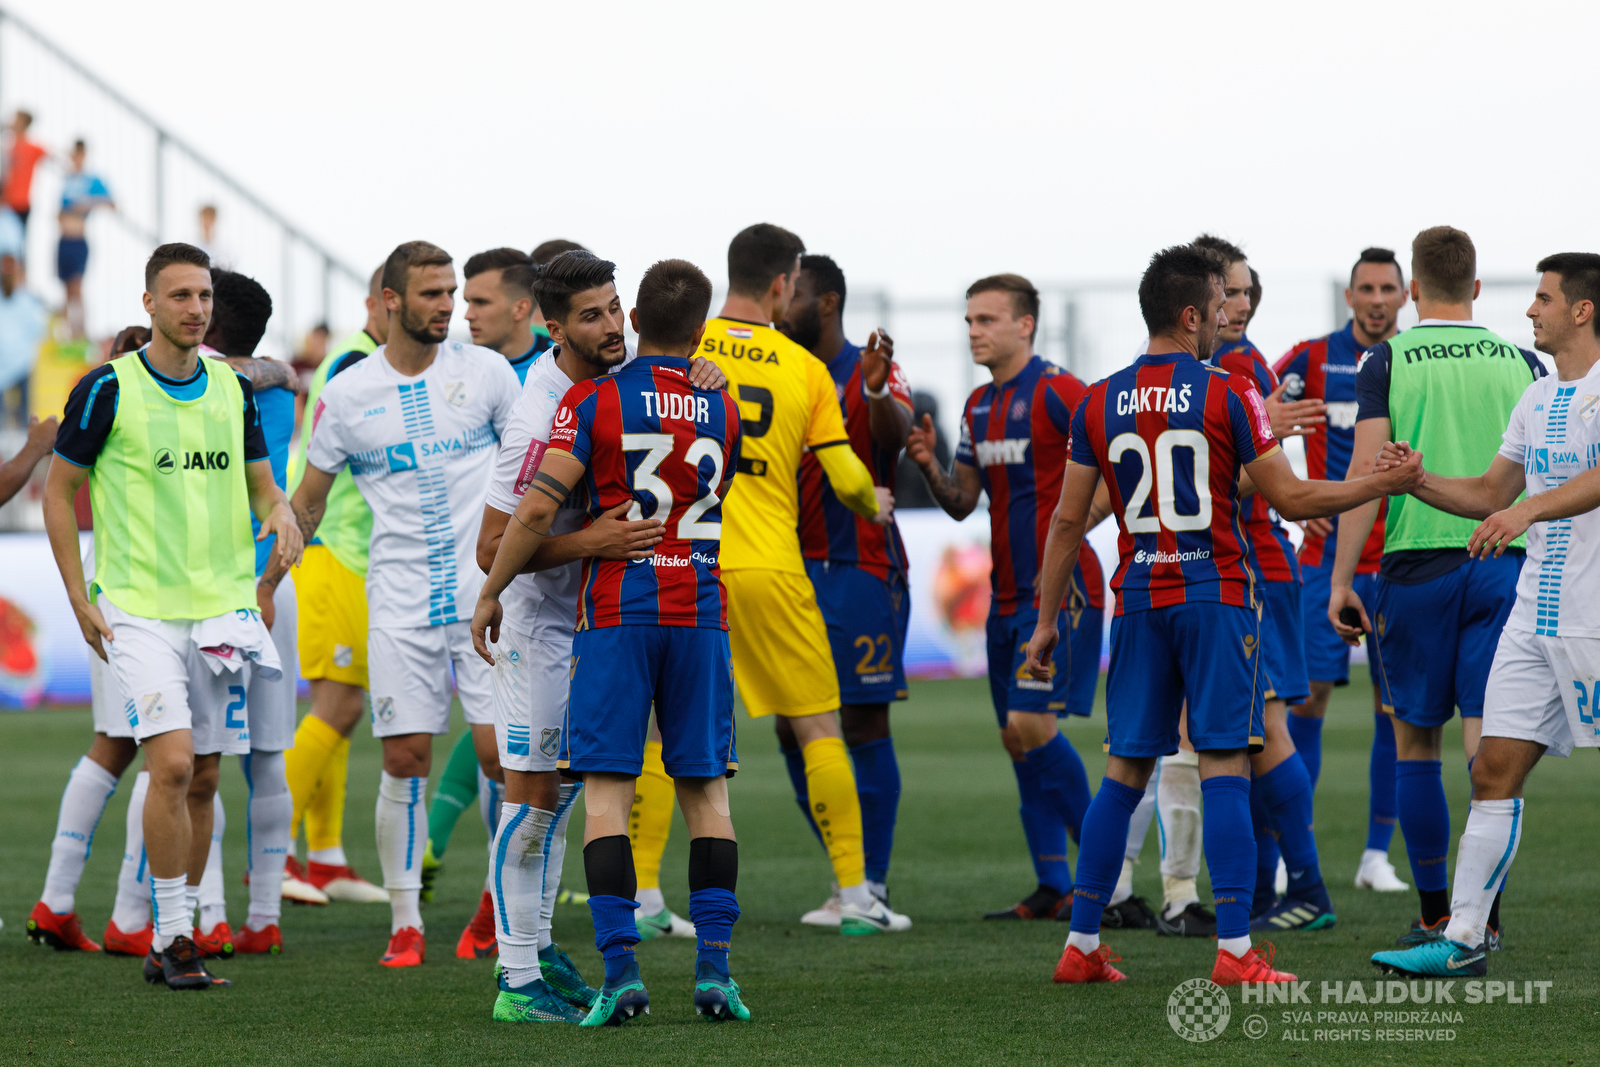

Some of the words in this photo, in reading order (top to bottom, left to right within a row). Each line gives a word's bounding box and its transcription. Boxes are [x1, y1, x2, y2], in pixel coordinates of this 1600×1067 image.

[703, 338, 780, 366] SLUGA
[1404, 340, 1516, 364] macron
[364, 406, 386, 418] JAKO
[641, 391, 709, 423] TUDOR
[1117, 383, 1192, 416] CAKTAŠ
[724, 381, 774, 476] 2
[183, 451, 230, 470] JAKO
[421, 438, 462, 456] SAVA
[1552, 451, 1580, 464] SAVA
[621, 433, 724, 541] 32
[1108, 429, 1213, 533] 20
[854, 633, 894, 675] 22
